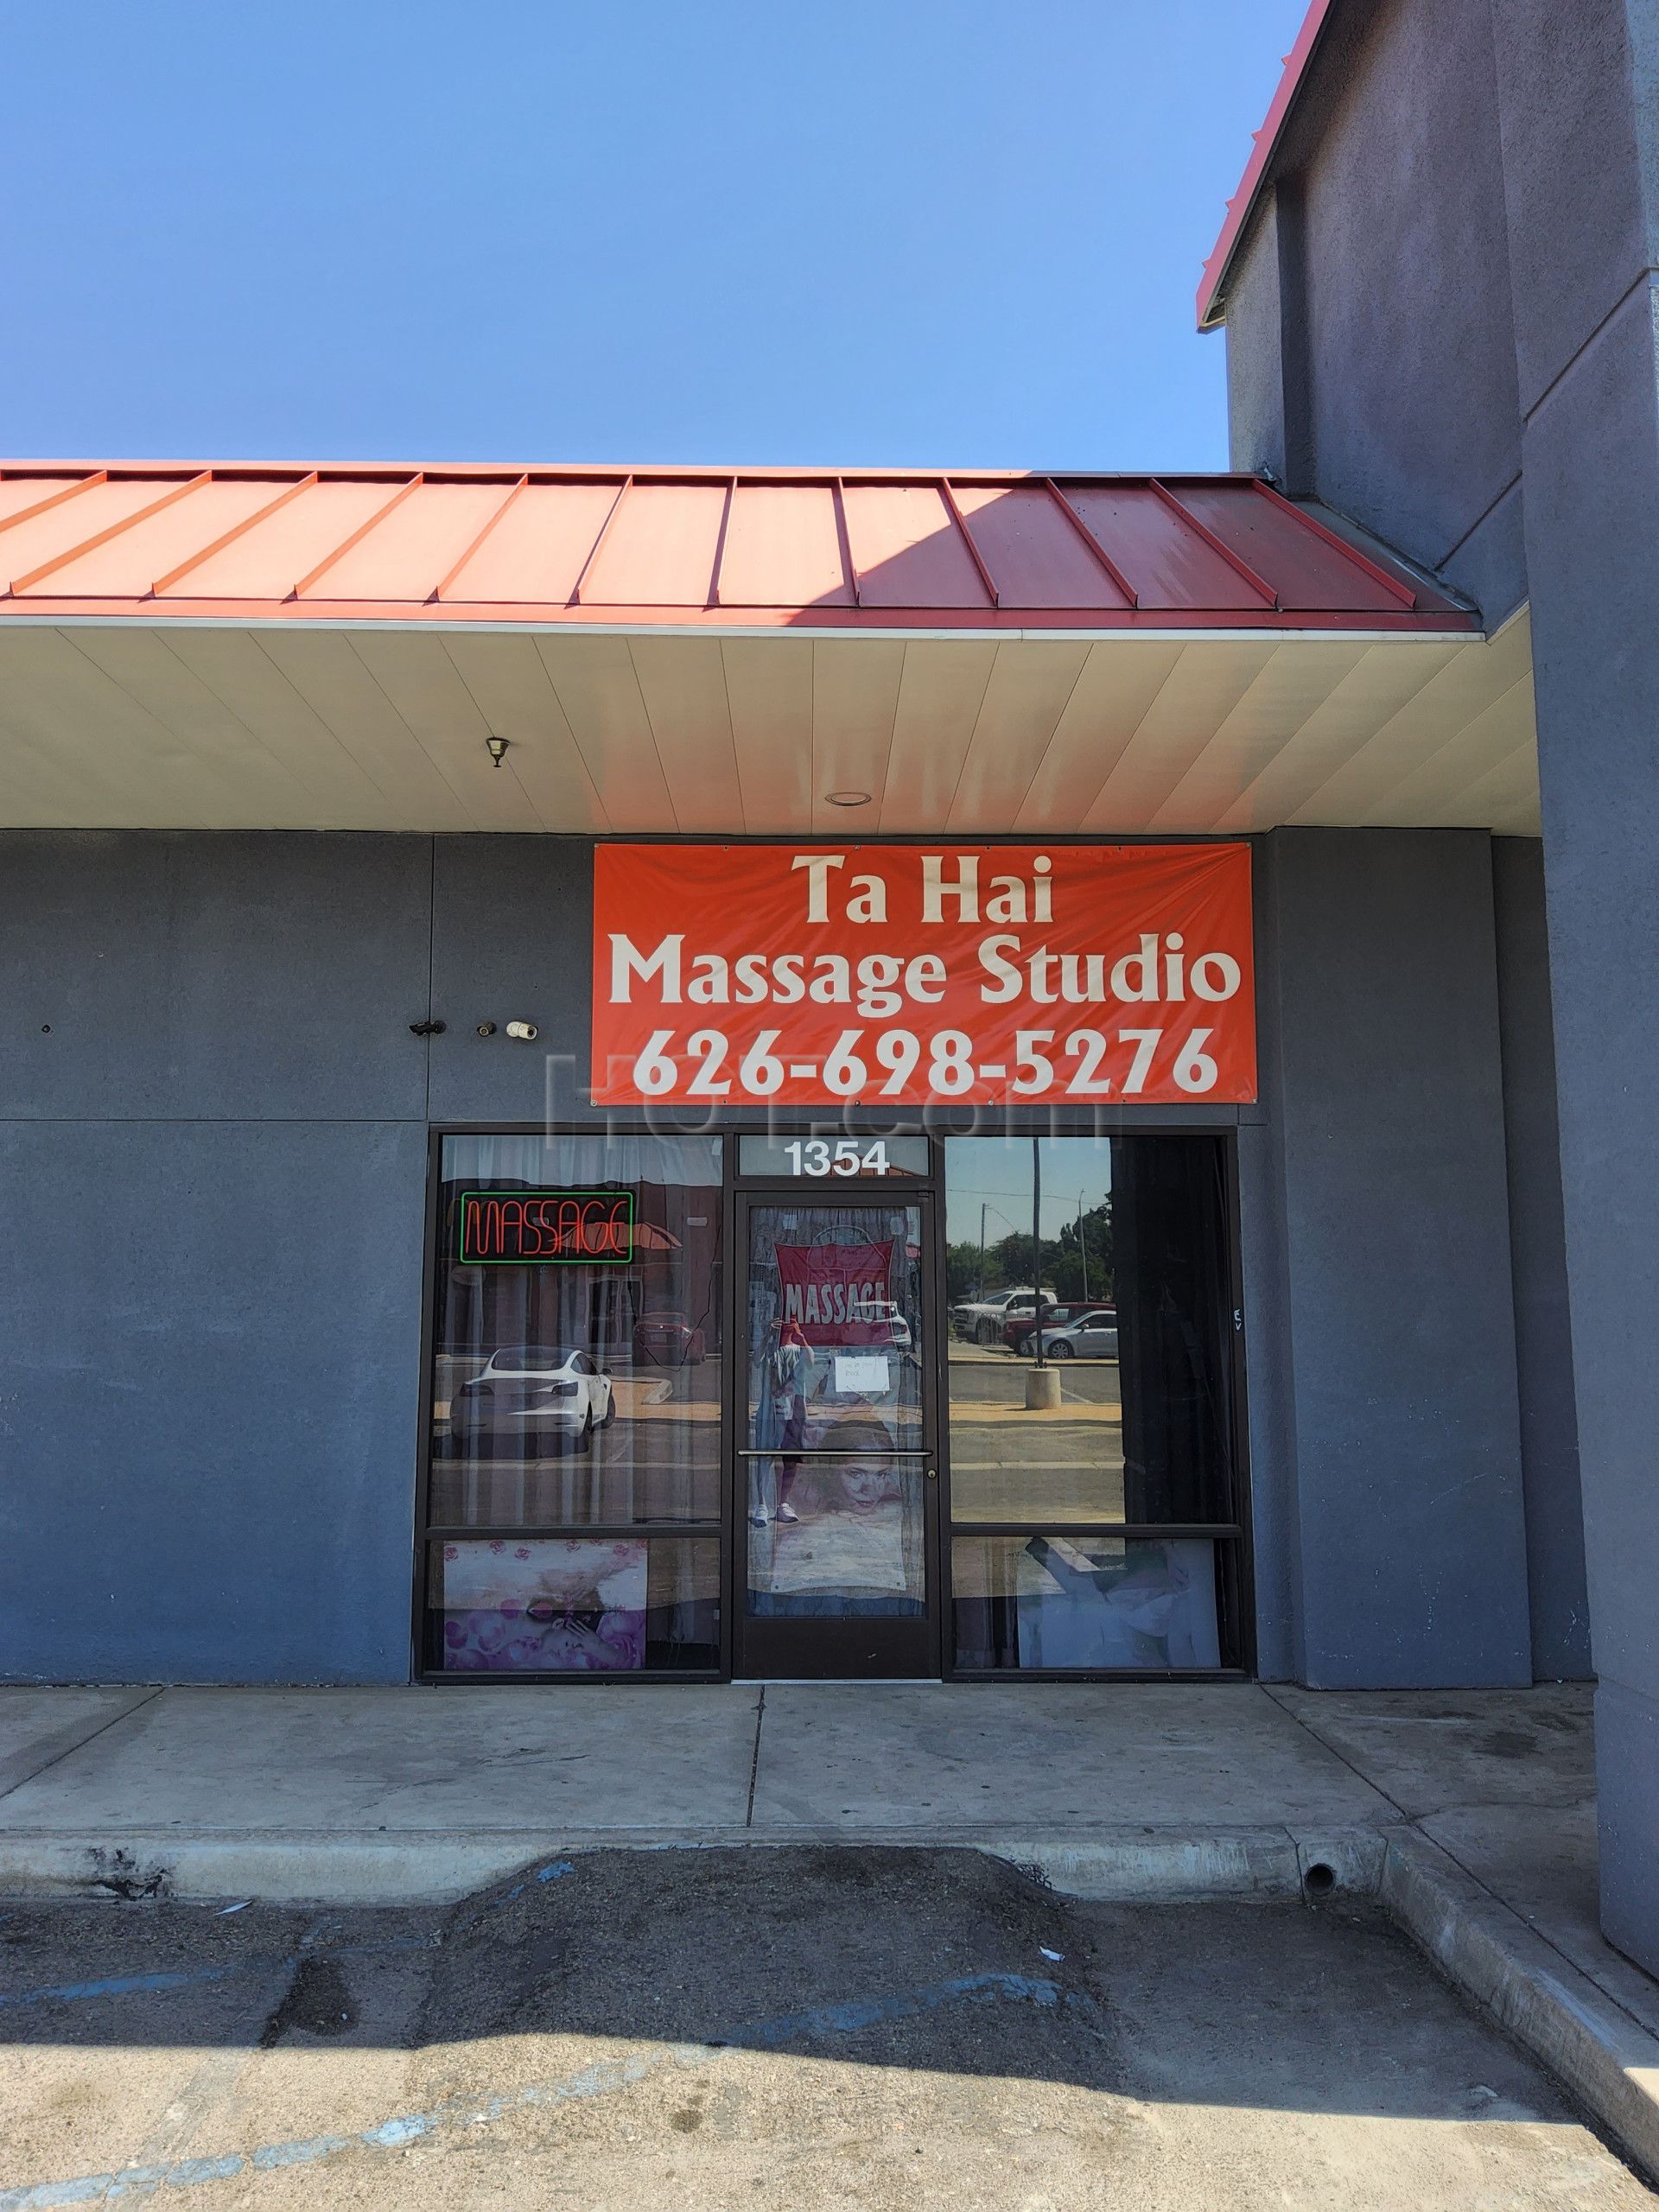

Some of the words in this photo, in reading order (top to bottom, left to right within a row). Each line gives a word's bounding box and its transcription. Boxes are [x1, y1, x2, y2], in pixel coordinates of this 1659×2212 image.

[791, 855, 888, 924] Ta
[921, 855, 1054, 924] Hai
[607, 933, 947, 1018] Massage
[978, 932, 1241, 1004] Studio
[633, 1028, 1218, 1096] 626-698-5276
[784, 1141, 890, 1176] 1354
[465, 1200, 628, 1255] MASSAGE
[785, 1282, 886, 1325] MASSAGE
